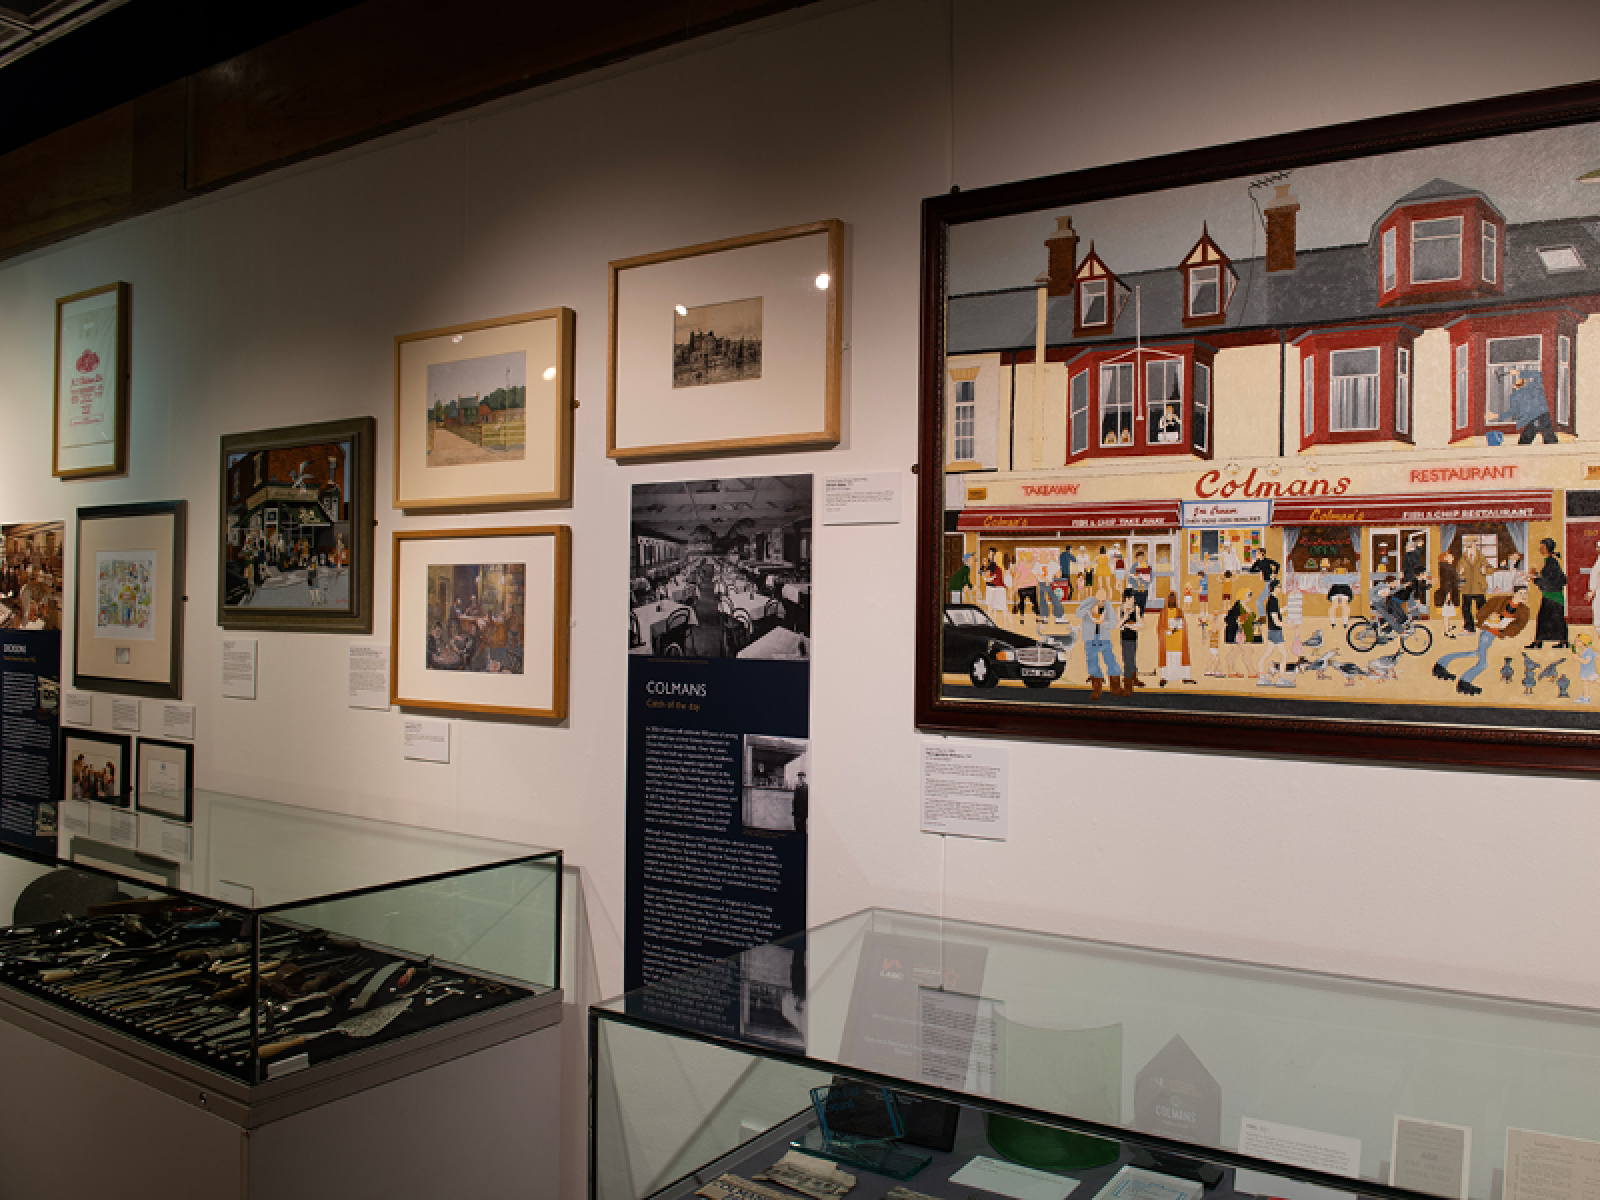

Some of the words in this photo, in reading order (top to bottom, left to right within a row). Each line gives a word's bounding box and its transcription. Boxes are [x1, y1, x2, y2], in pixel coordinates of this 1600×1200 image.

[1409, 465, 1518, 483] RESTAURANT
[1021, 483, 1081, 497] TAKEAWAY
[1194, 468, 1351, 498] Colmans
[1461, 508, 1534, 519] RESTAURANT
[645, 681, 707, 697] COLMANS
